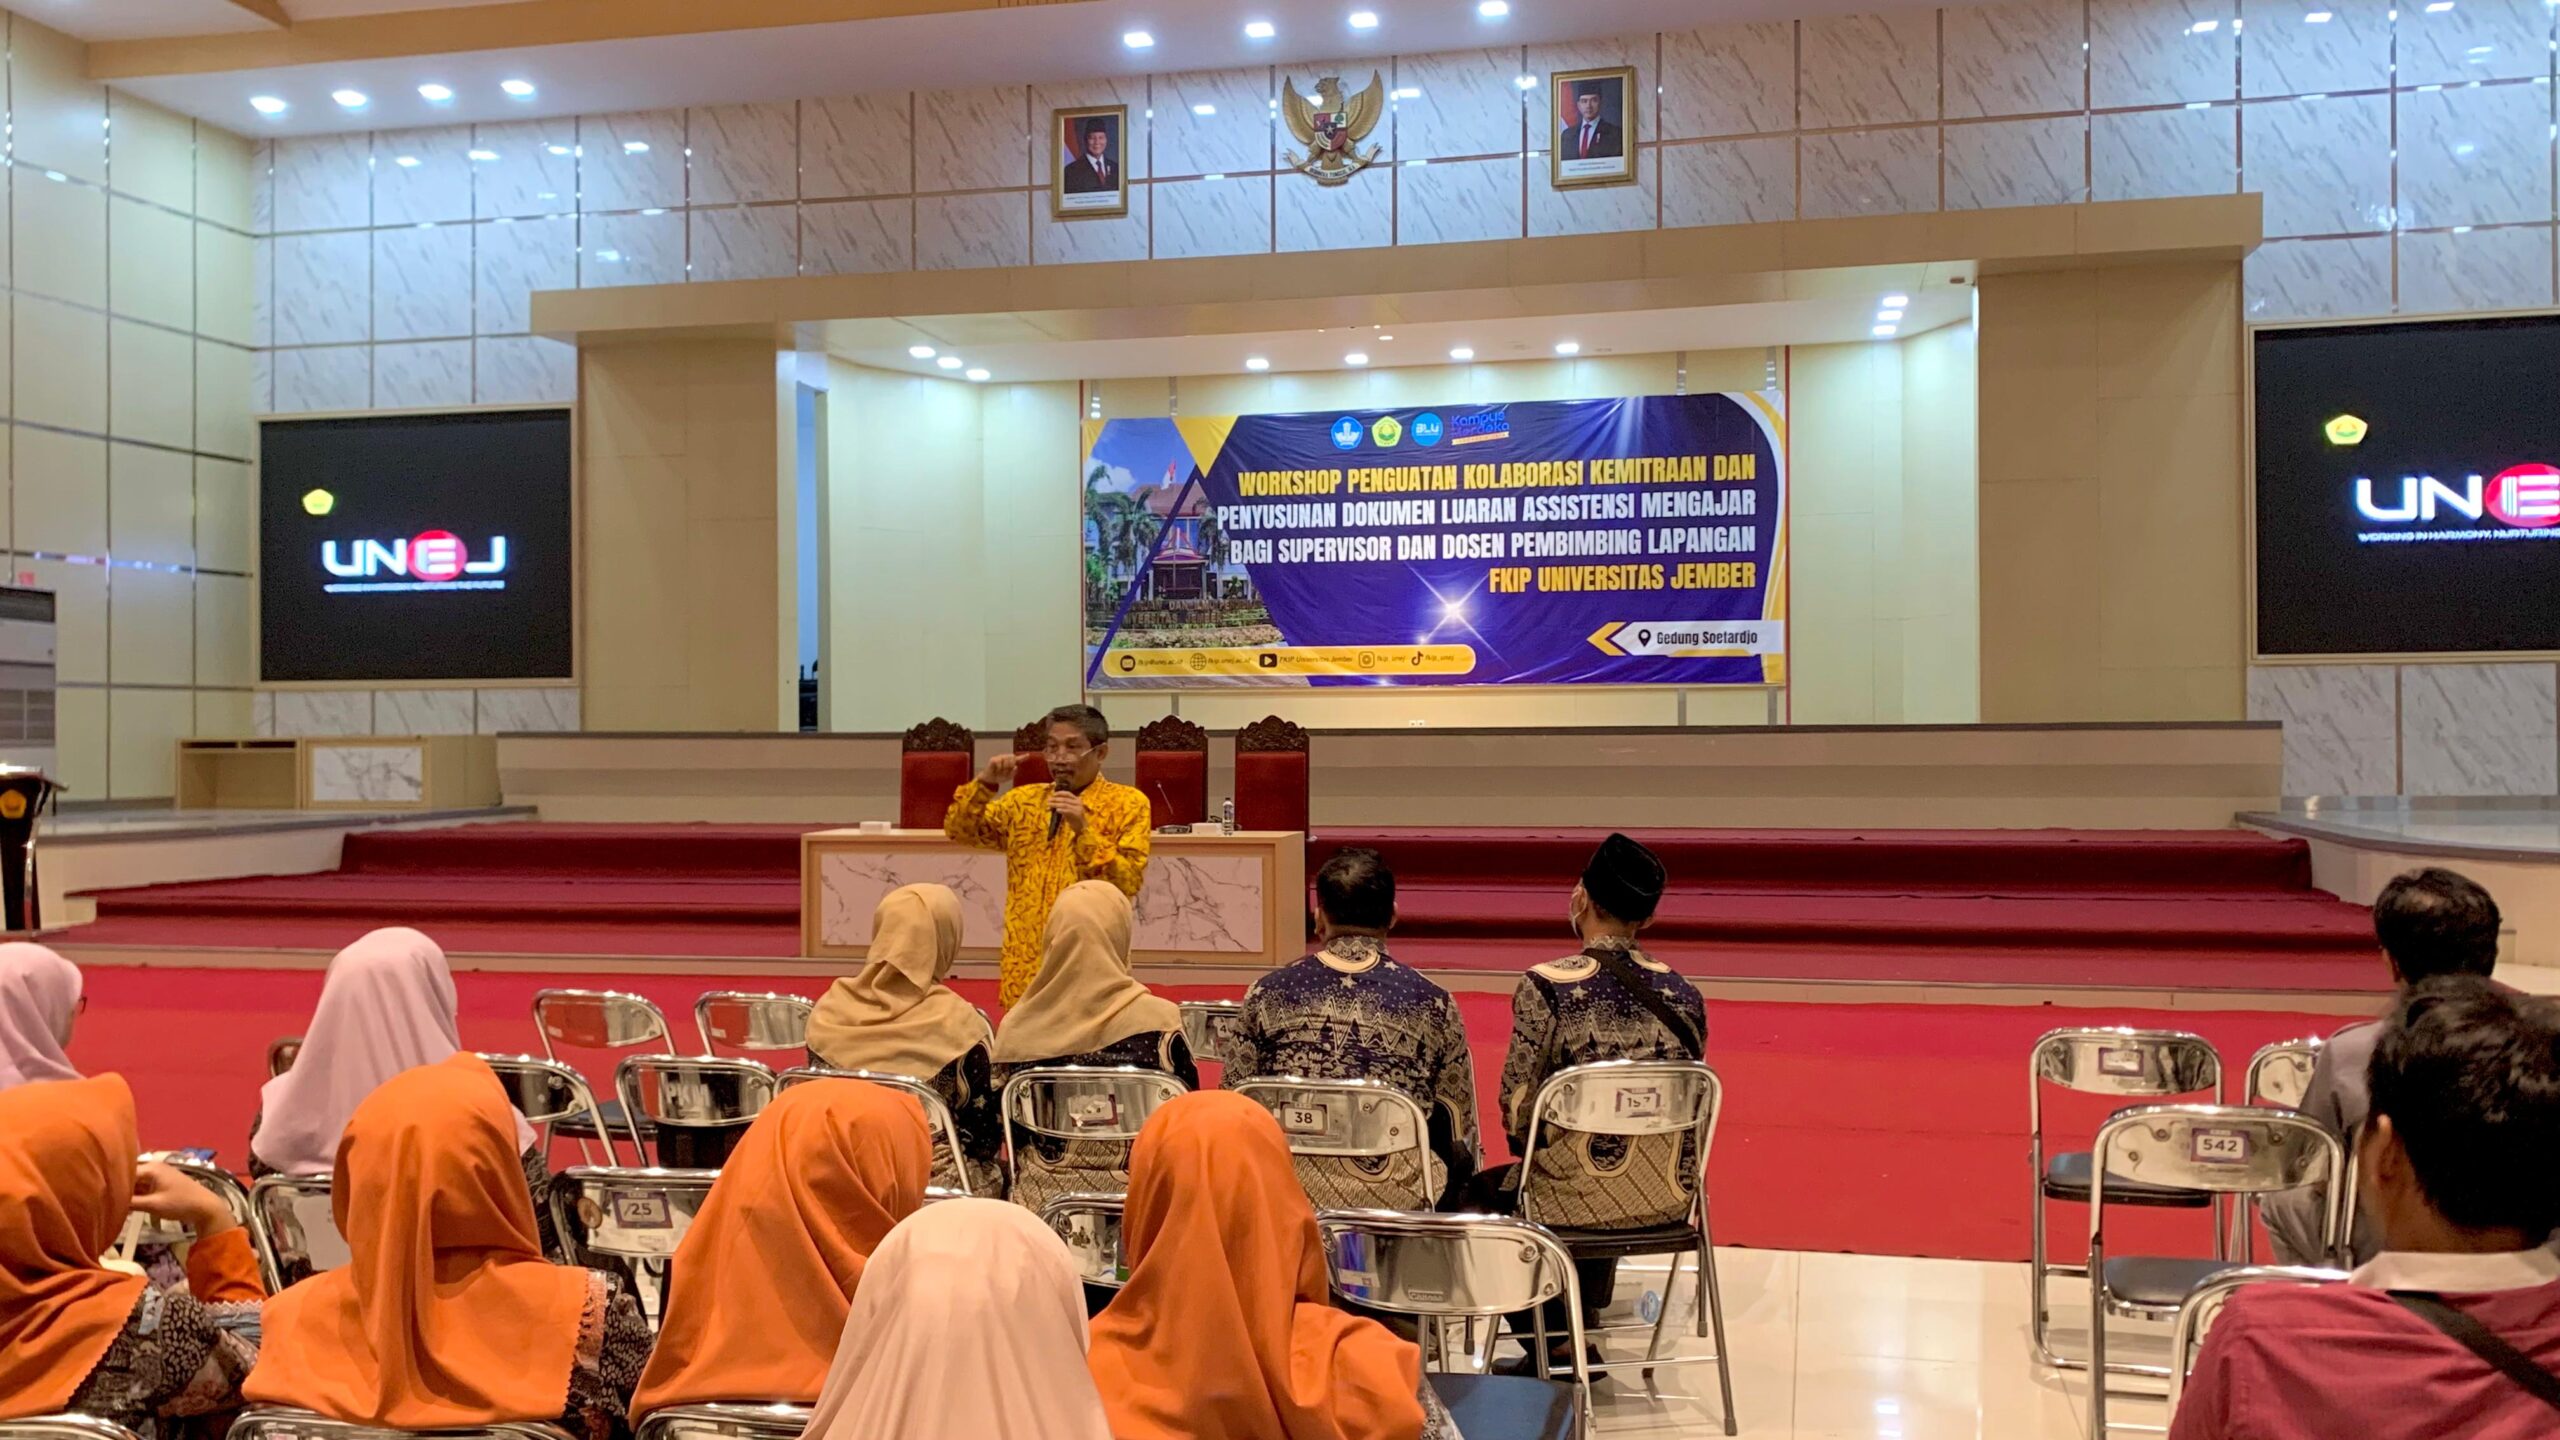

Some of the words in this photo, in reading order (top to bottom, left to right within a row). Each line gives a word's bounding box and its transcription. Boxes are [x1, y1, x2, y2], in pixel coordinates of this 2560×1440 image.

[1452, 411, 1505, 428] Kampus
[1238, 469, 1342, 496] WORKSHOP
[1347, 465, 1457, 493] PENGUATAN
[1464, 460, 1584, 489] KOLABORASI
[1590, 456, 1707, 485] KEMITRAAN
[1713, 454, 1756, 481] DAN
[1217, 503, 1336, 530] PENYUSUNAN
[1342, 499, 1435, 527] DOKUMEN
[1441, 496, 1516, 524] LUARAN
[1522, 492, 1635, 521] ASSISTENSI
[1641, 489, 1756, 518] MENGAJAR
[1231, 539, 1273, 564] BAGI
[1278, 536, 1392, 563] SUPERVISOR
[1398, 534, 1436, 561] DAN
[1442, 532, 1504, 560] DOSEN
[1511, 529, 1642, 557] PEMBIMBING
[1648, 526, 1756, 554] LAPANGAN
[2358, 532, 2414, 542] WORKING
[2415, 531, 2427, 541] IN
[322, 536, 506, 577] UNEJ
[1489, 567, 1532, 593] FKIP
[1538, 564, 1664, 592] UNIVERSITAS
[1670, 561, 1756, 589] JEMBER
[1657, 632, 1699, 645] Gedung
[1702, 631, 1758, 644] Soetardjo
[1294, 1111, 1313, 1124] 38
[2203, 1138, 2238, 1152] 542
